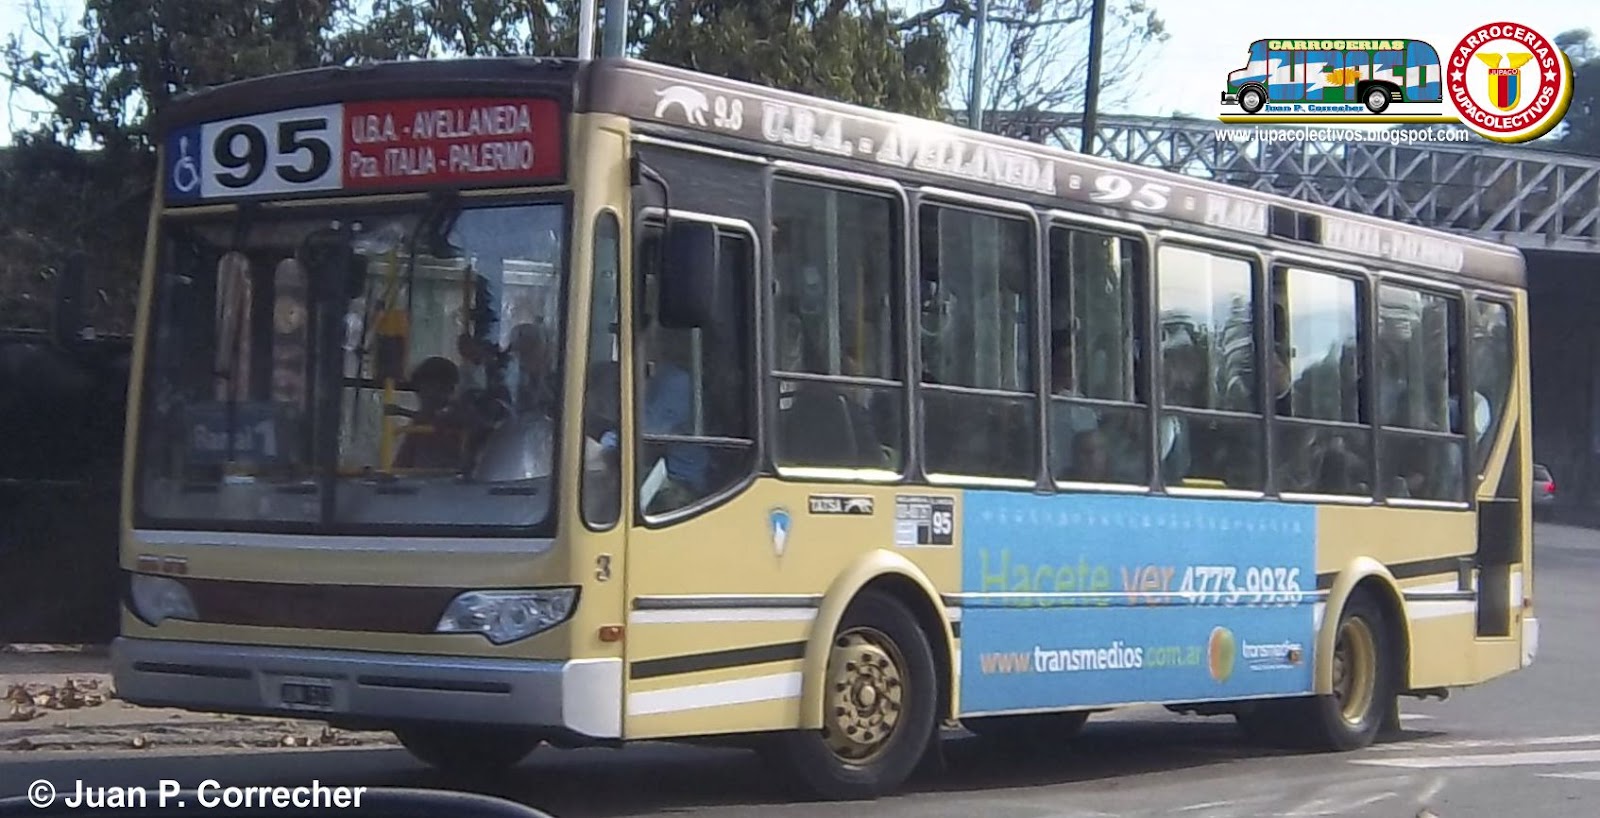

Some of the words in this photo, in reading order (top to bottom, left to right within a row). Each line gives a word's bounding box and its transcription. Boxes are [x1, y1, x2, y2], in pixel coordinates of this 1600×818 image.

[412, 104, 532, 140] AVELLANEDA
[212, 117, 333, 189] 95
[384, 147, 437, 177] ITALIA
[449, 140, 535, 174] PALERMO
[760, 101, 854, 156] U.B.A.
[876, 128, 1058, 196] AVELLANEDA
[1089, 174, 1171, 211] 95
[932, 511, 952, 535] 95
[596, 554, 611, 582] 3
[980, 549, 1113, 606] Hacete
[1120, 562, 1176, 607] ver
[1179, 565, 1303, 608] 4773-9936
